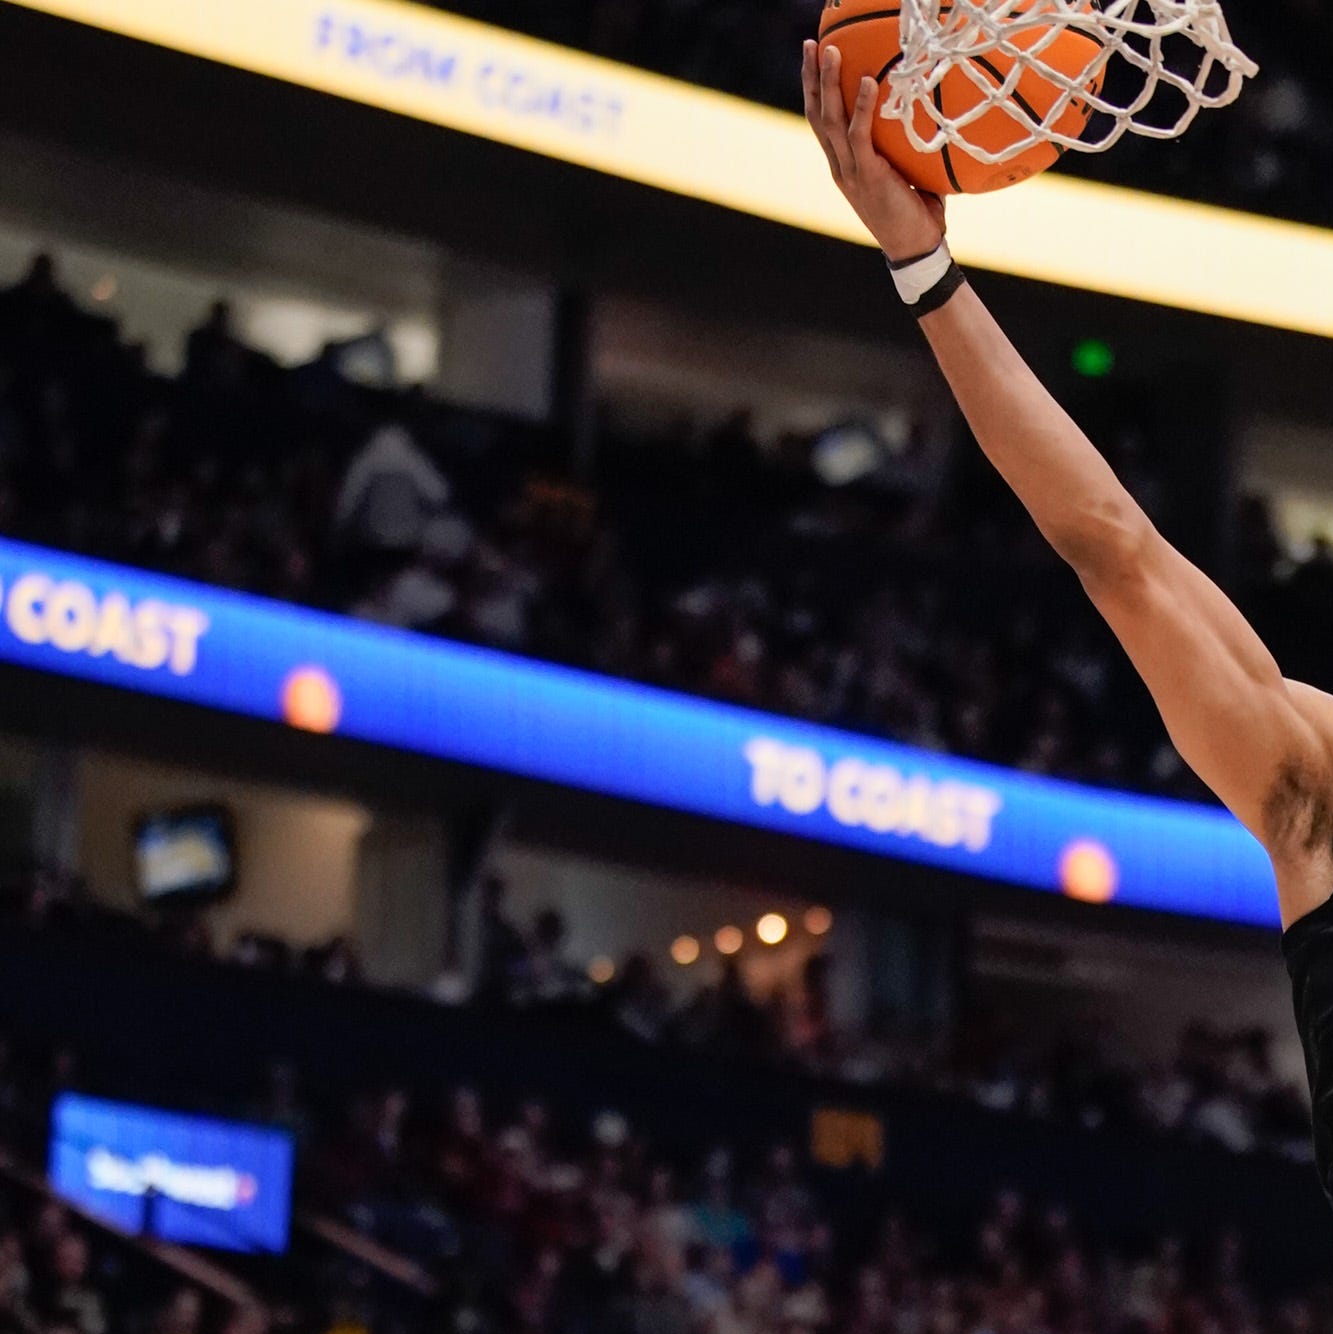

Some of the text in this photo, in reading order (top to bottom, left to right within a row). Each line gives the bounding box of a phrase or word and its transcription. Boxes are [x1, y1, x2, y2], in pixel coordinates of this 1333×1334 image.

[315, 15, 624, 133] FROM COAST
[6, 570, 210, 677] COAST
[744, 736, 1003, 853] TO COAST
